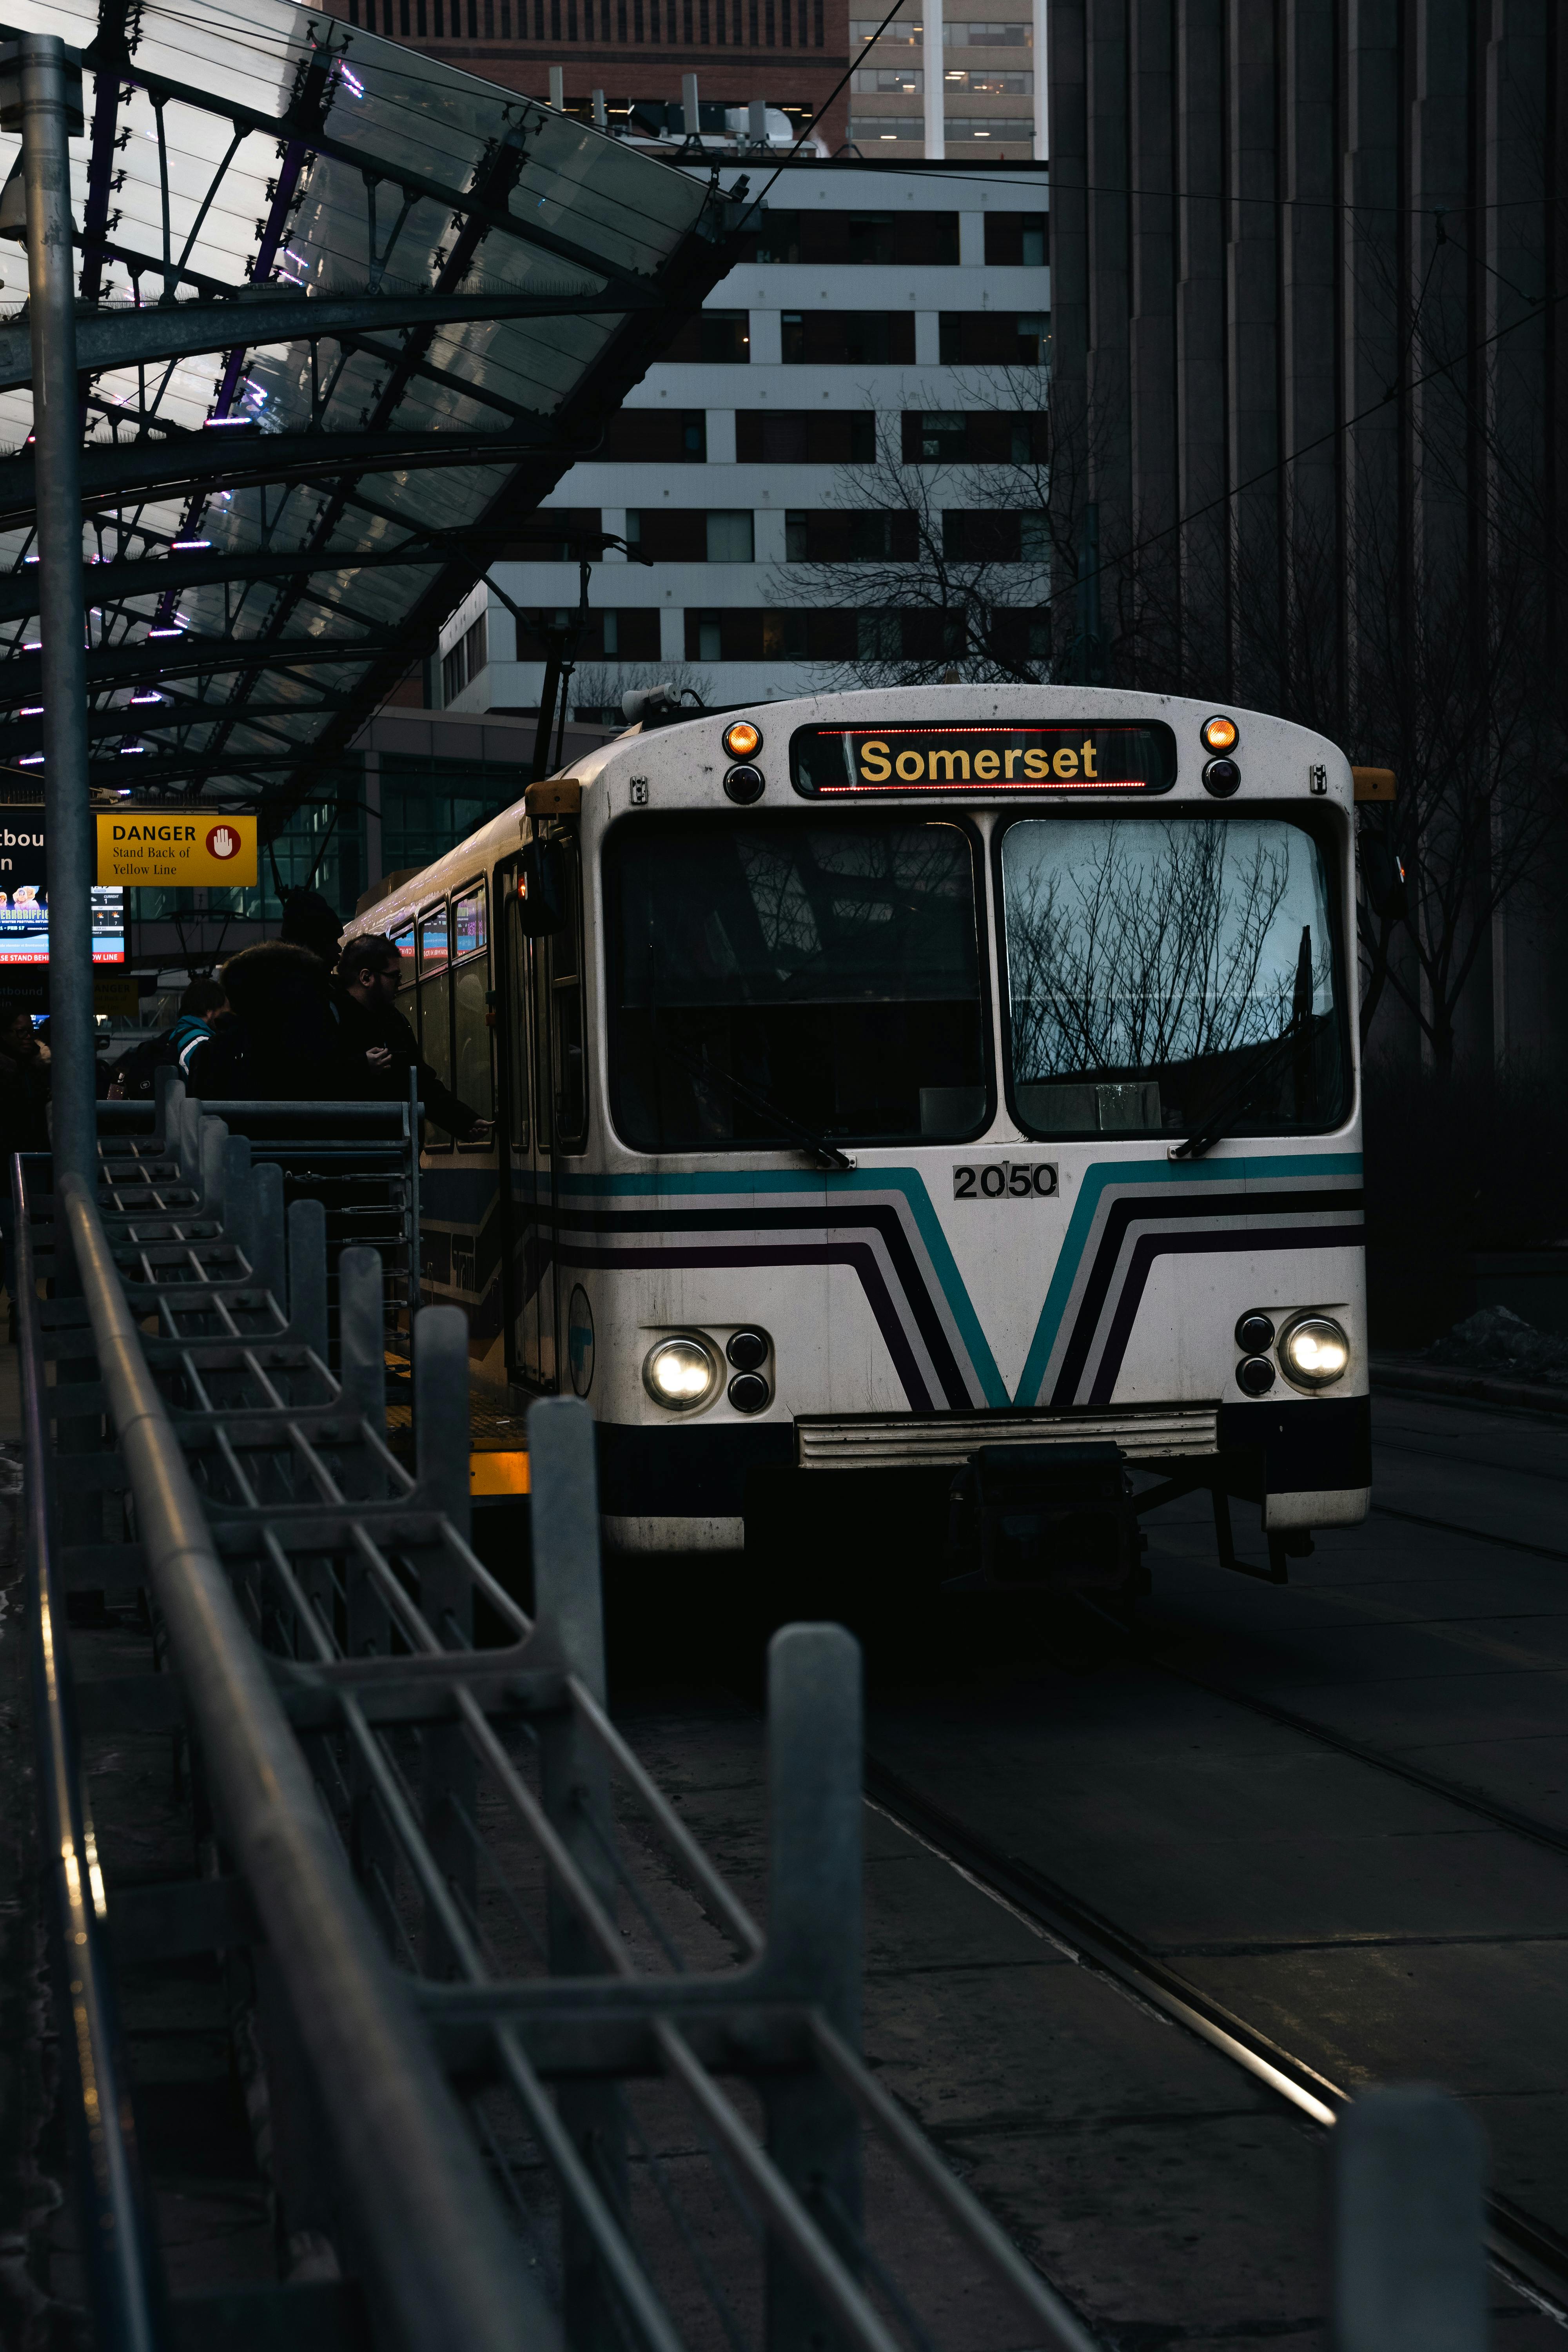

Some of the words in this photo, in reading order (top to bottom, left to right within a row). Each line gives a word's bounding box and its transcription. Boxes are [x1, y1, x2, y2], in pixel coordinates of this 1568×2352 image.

[860, 739, 1097, 781] Somerset
[113, 826, 196, 840] DANGER
[113, 847, 143, 857] Stand
[148, 847, 175, 858] Back
[179, 847, 191, 858] of
[113, 864, 149, 875] Yellow
[154, 865, 177, 875] Line
[955, 1164, 1057, 1198] 2050
